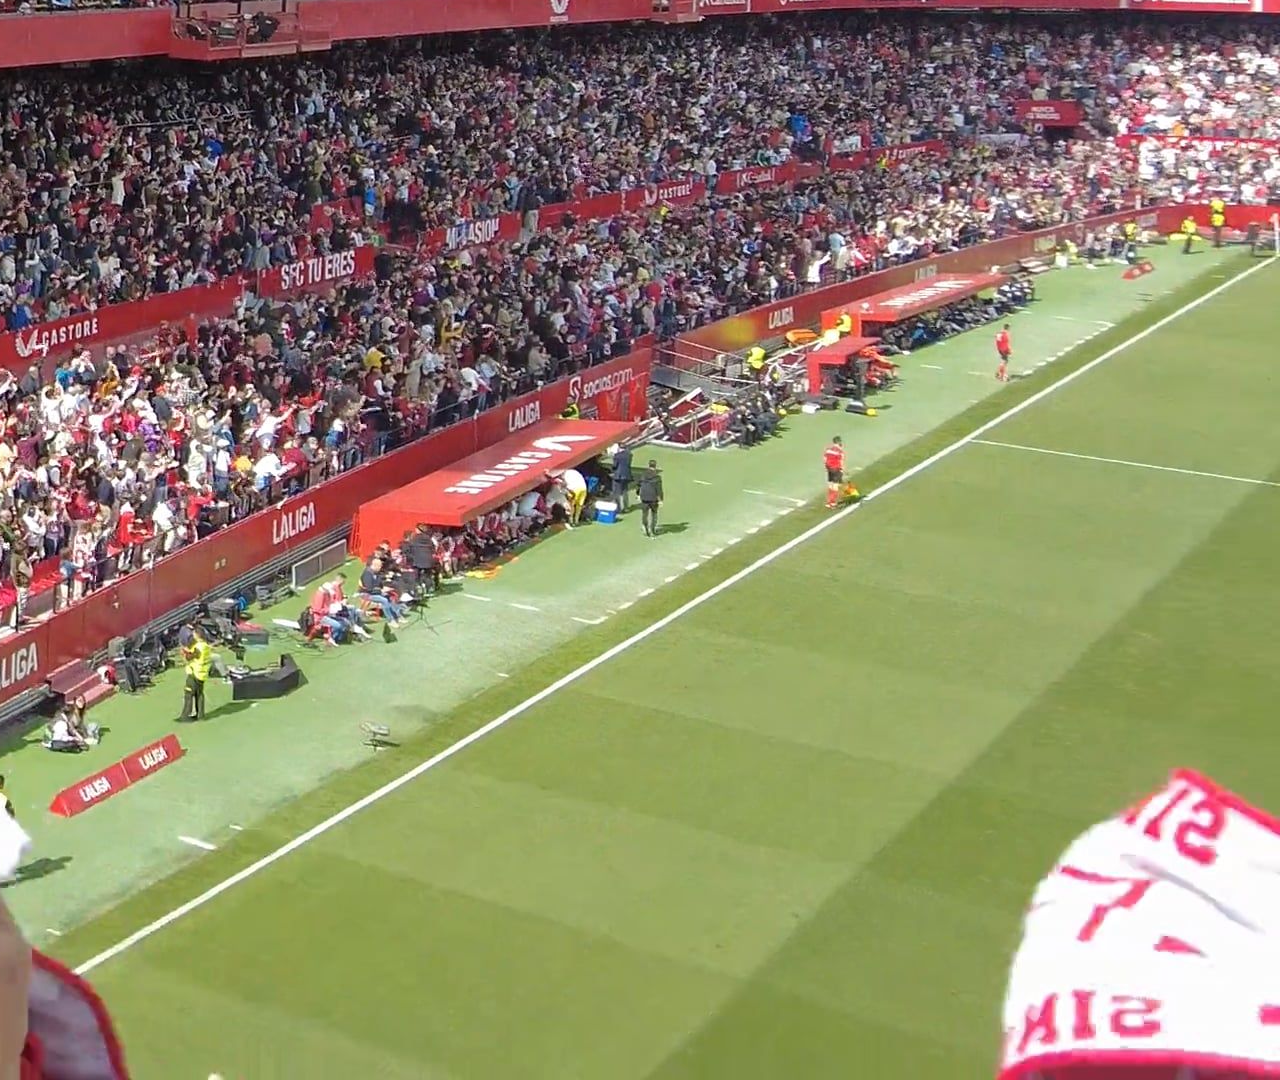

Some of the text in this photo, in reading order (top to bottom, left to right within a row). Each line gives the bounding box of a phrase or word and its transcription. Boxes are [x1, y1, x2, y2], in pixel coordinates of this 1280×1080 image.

[280, 250, 356, 290] SFC TU ERES
[42, 317, 99, 347] CASTORE
[508, 400, 540, 433] LALIGA
[272, 501, 316, 545] LALIGA
